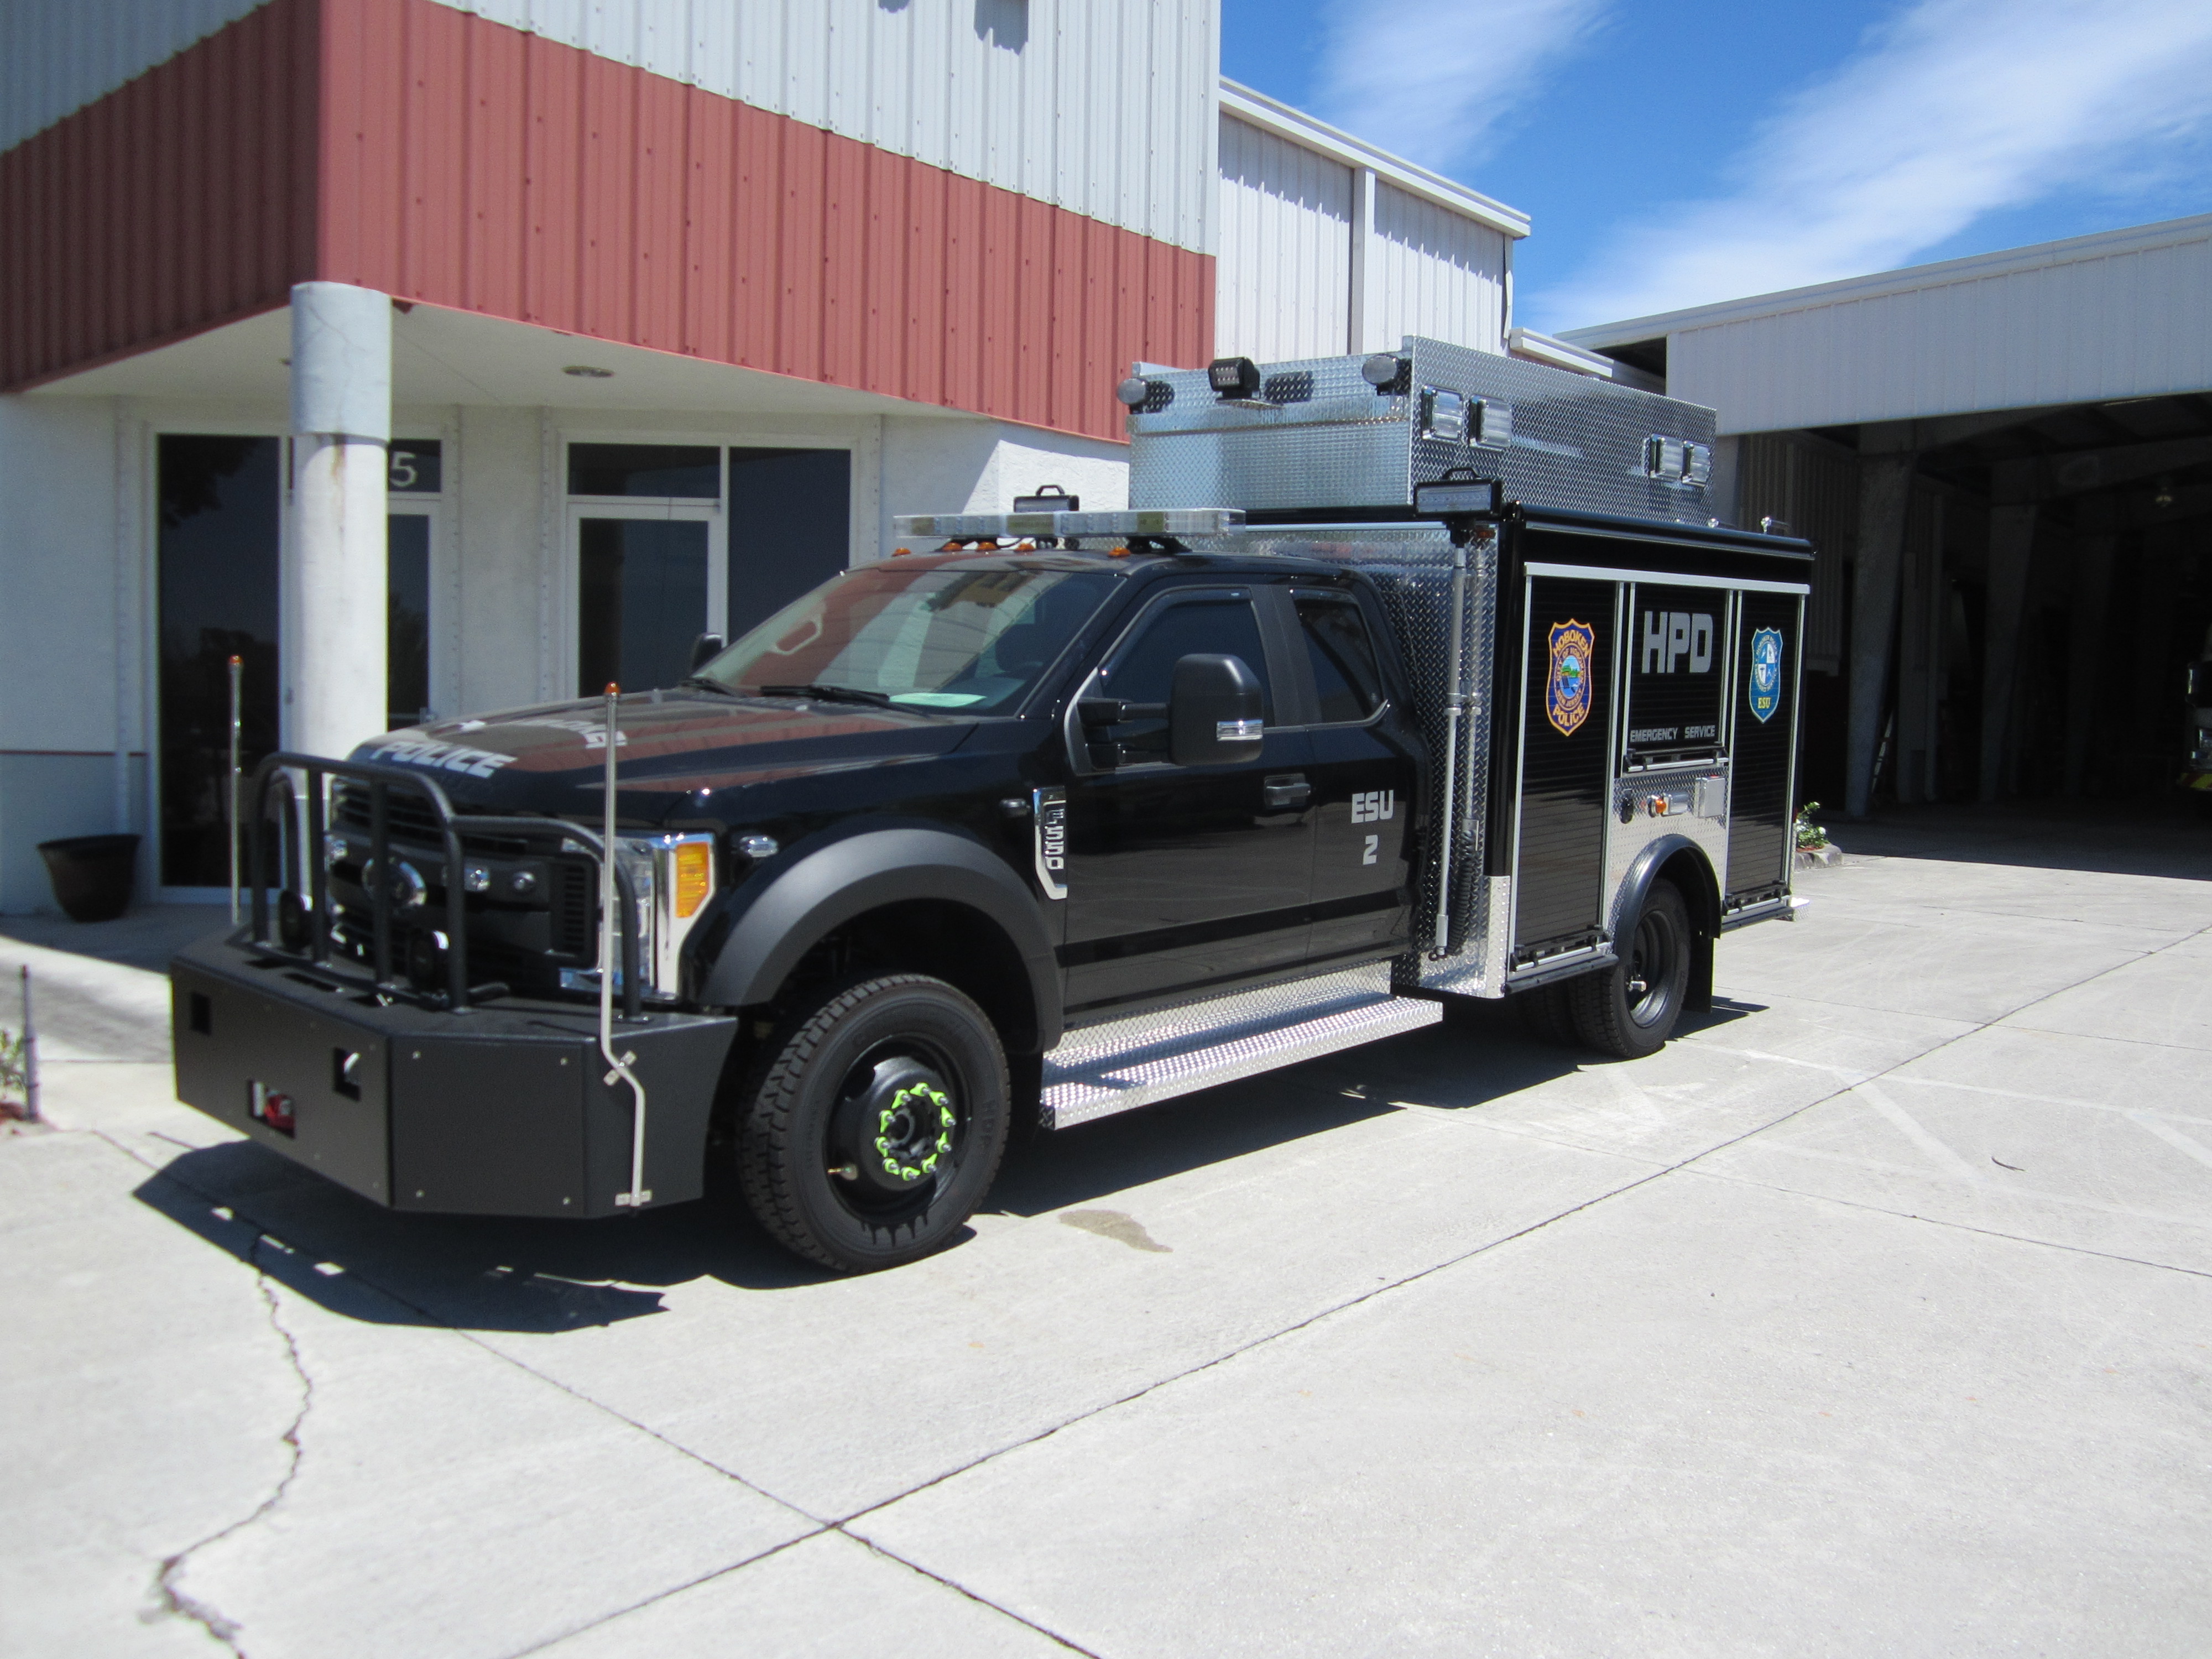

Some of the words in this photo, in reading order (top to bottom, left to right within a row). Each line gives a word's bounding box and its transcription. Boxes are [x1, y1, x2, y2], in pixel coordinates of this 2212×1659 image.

[390, 451, 418, 487] 5
[1553, 629, 1590, 658] HOBOKEN
[1641, 611, 1713, 674] HPD
[1553, 703, 1585, 727] POLICE
[1757, 697, 1771, 708] ESU
[1630, 727, 1678, 742] EMERGENCY
[1684, 725, 1715, 739] SERVICE
[369, 741, 519, 779] POLICE
[1351, 790, 1394, 823] ESU
[1363, 834, 1379, 865] 2
